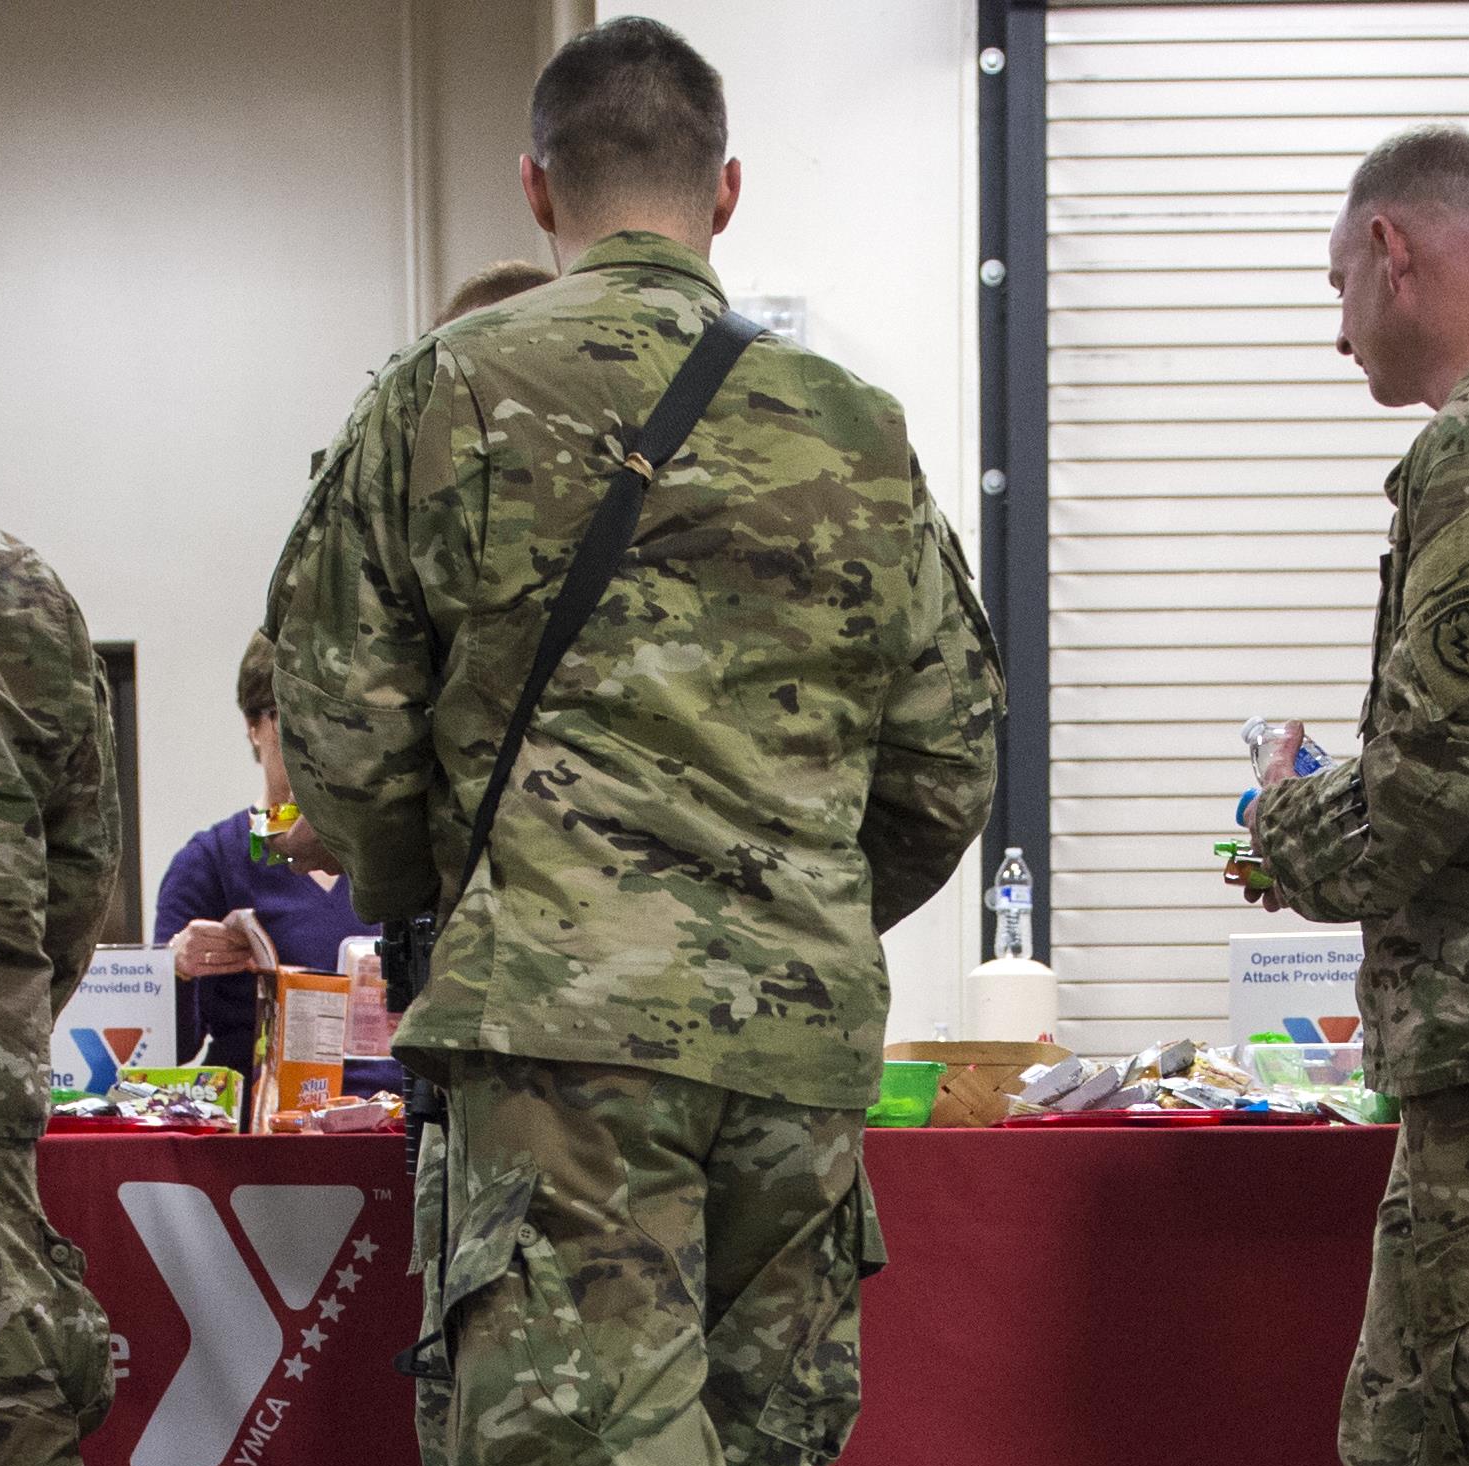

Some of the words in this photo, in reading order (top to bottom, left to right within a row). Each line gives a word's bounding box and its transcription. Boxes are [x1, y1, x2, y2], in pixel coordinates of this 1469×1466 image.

[1251, 952, 1322, 967] Operation
[1327, 951, 1363, 964] Snac
[111, 963, 153, 976] Snack
[1242, 970, 1289, 983] Attack
[79, 981, 143, 994] Provided
[145, 981, 161, 996] By
[51, 1071, 74, 1087] he
